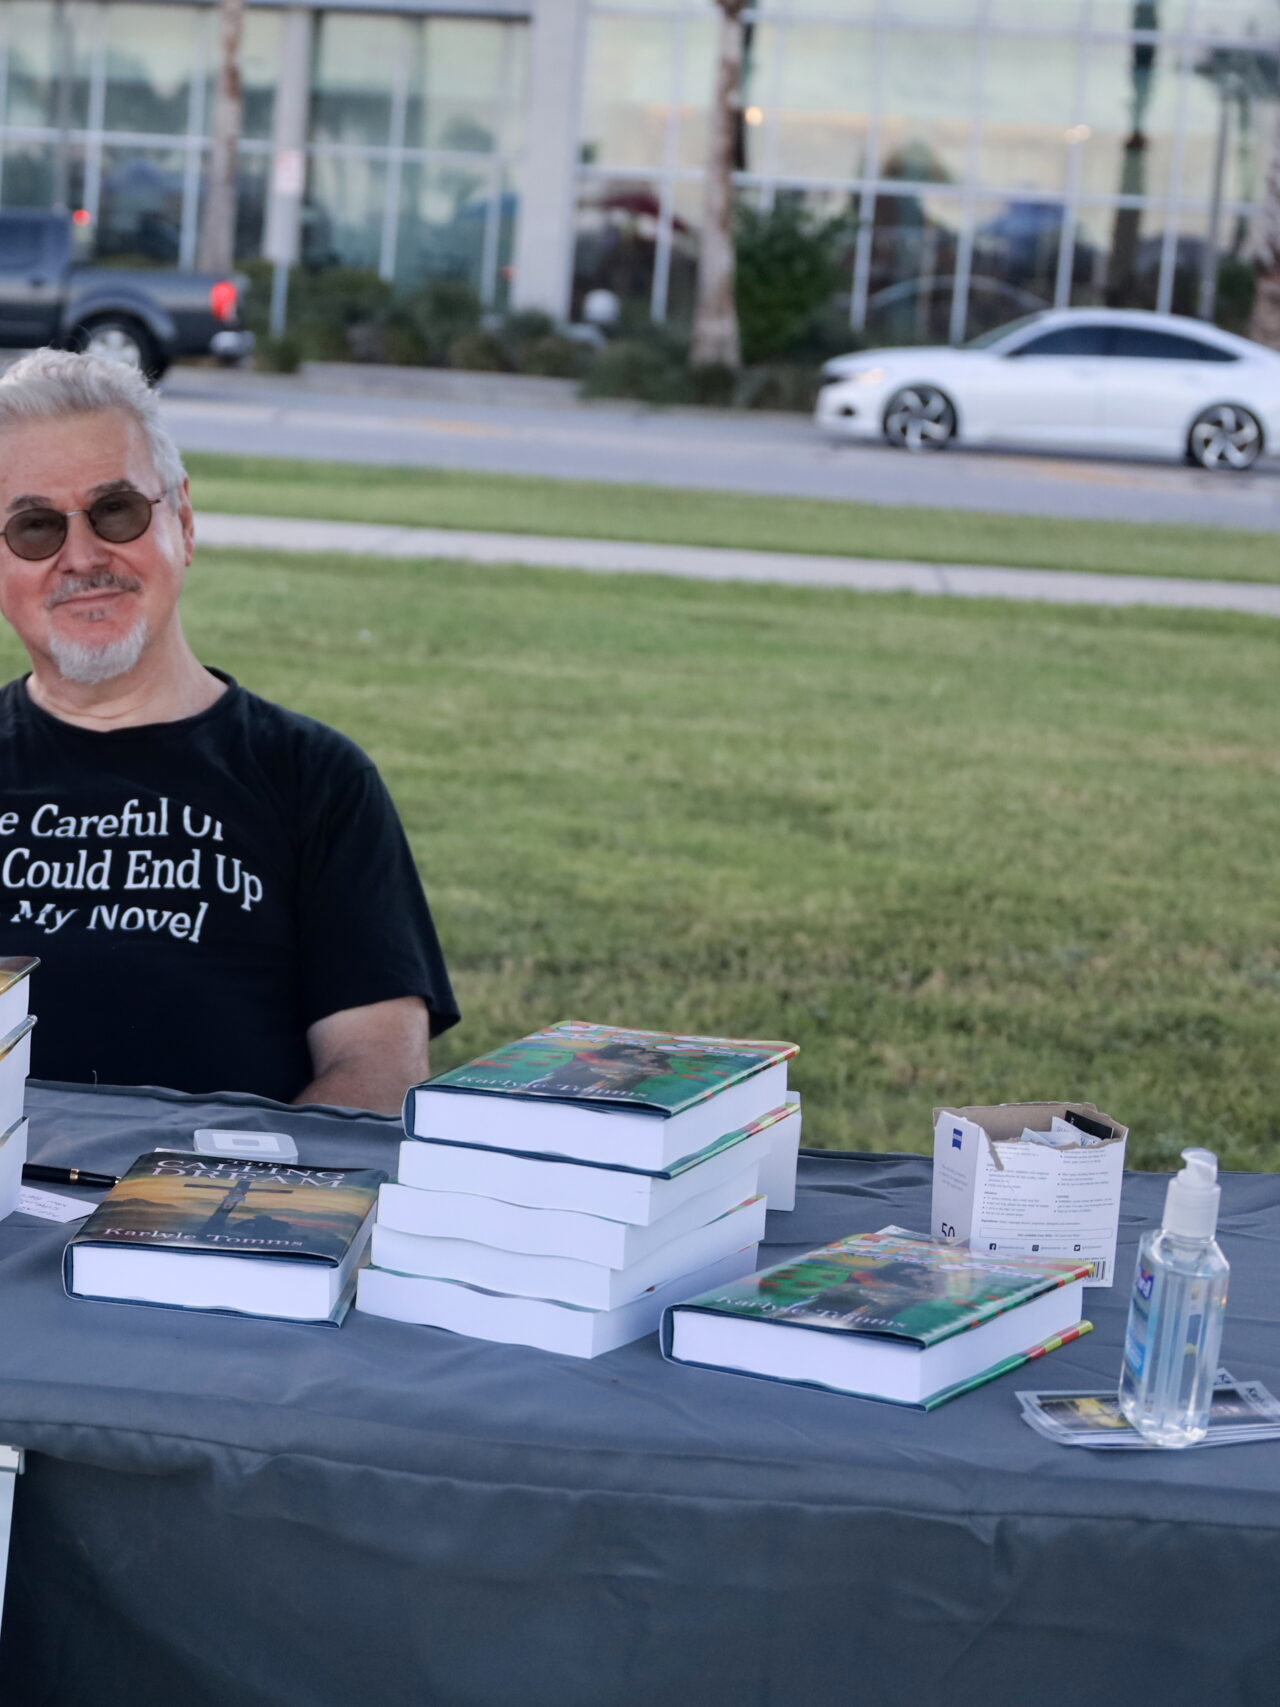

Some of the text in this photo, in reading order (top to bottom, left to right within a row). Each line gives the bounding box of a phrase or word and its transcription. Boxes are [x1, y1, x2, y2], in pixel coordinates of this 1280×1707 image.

[31, 797, 169, 838] Careful
[2, 848, 112, 890] Could
[124, 848, 202, 890] End
[215, 853, 264, 911] Up
[10, 900, 79, 934] My
[86, 901, 209, 943] Novel
[152, 1167, 345, 1188] DREAM
[157, 1160, 346, 1181] CALLING
[104, 1227, 304, 1247] Karlyle Tomms
